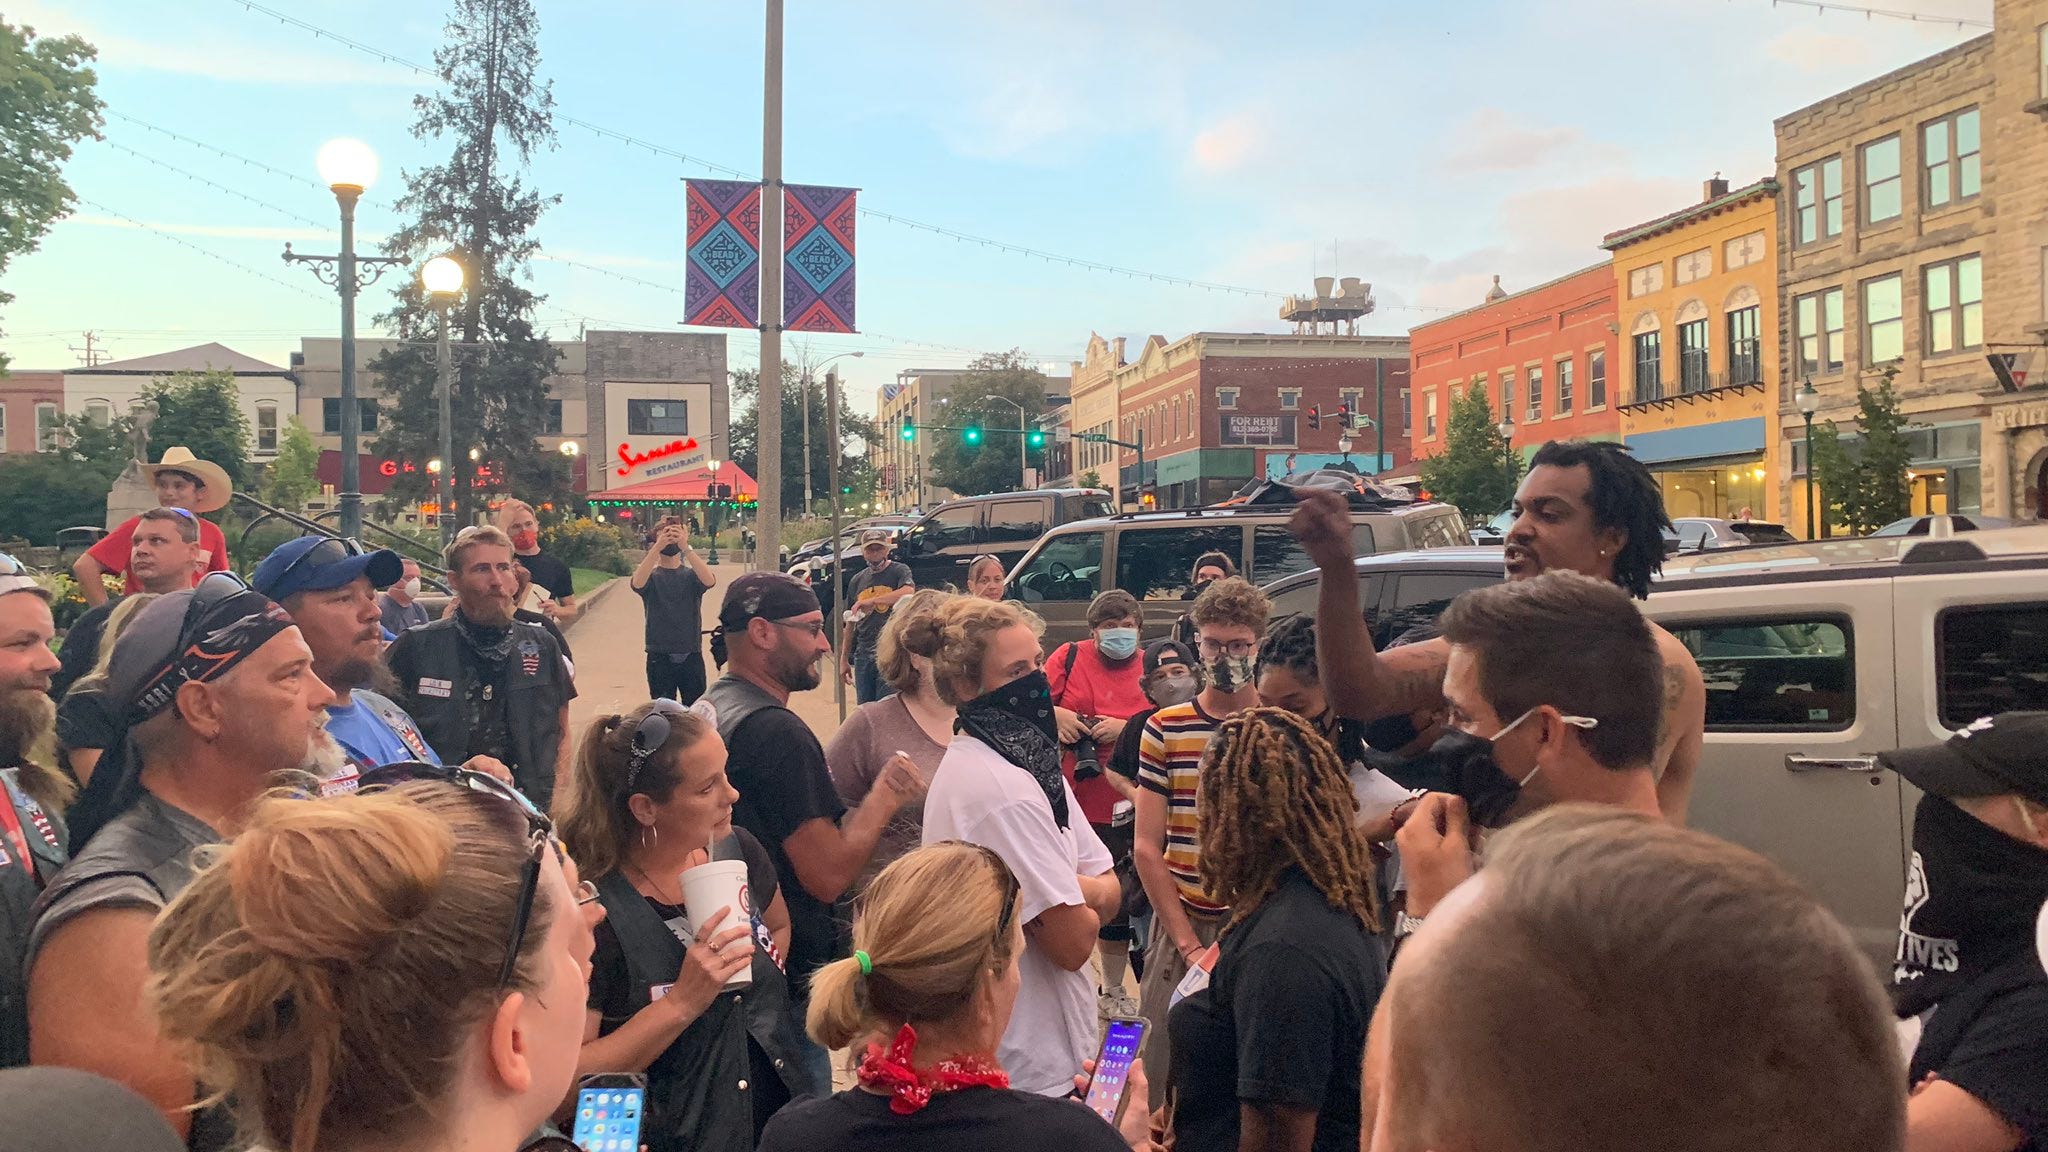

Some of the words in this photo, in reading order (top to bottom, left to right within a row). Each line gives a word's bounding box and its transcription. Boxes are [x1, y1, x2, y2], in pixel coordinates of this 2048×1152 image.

[712, 250, 735, 259] BEAD
[809, 255, 831, 264] BEAD
[1231, 416, 1251, 425] FOR
[1253, 416, 1279, 426] RENT
[645, 453, 705, 477] RESTAURANT
